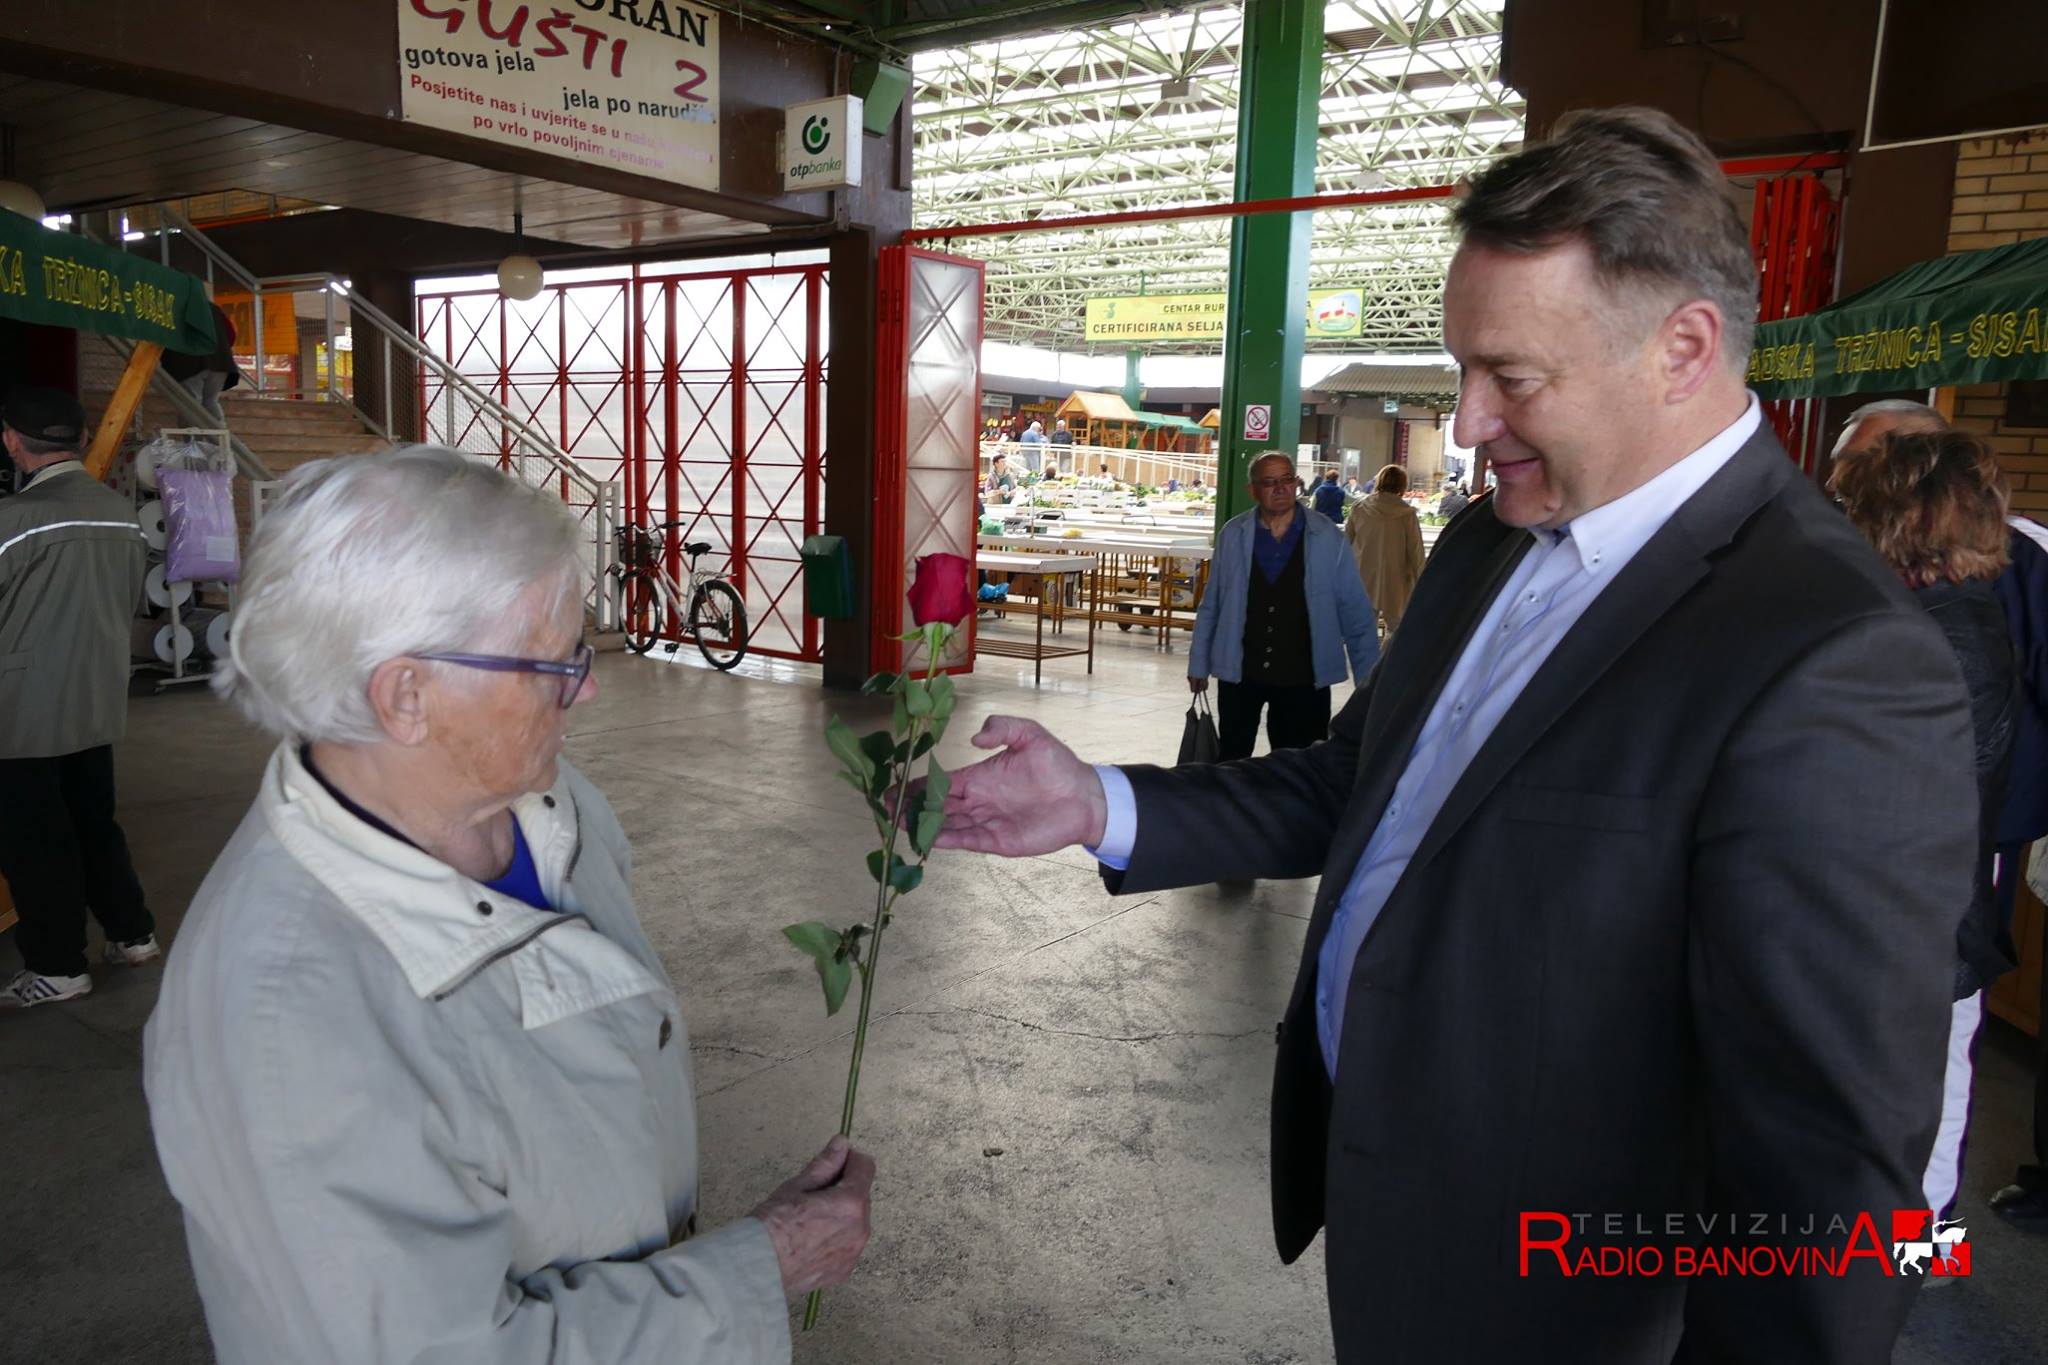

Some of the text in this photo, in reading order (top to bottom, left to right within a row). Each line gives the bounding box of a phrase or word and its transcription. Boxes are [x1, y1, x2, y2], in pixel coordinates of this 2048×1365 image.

[405, 48, 535, 74] gotova jela
[673, 59, 708, 103] 2
[410, 74, 485, 105] Posjetite
[490, 98, 517, 113] nas
[521, 102, 526, 115] i
[531, 108, 588, 131] uvjerite
[592, 122, 607, 136] se
[611, 130, 620, 139] u
[562, 87, 599, 110] jela
[607, 97, 631, 115] po
[473, 115, 493, 129] po
[499, 121, 528, 137] vrlo
[533, 130, 604, 155] povoljnim
[1163, 304, 1201, 313] CENTAR
[1093, 320, 1183, 334] CERTIFICIRANA
[1966, 308, 2048, 359] SISA
